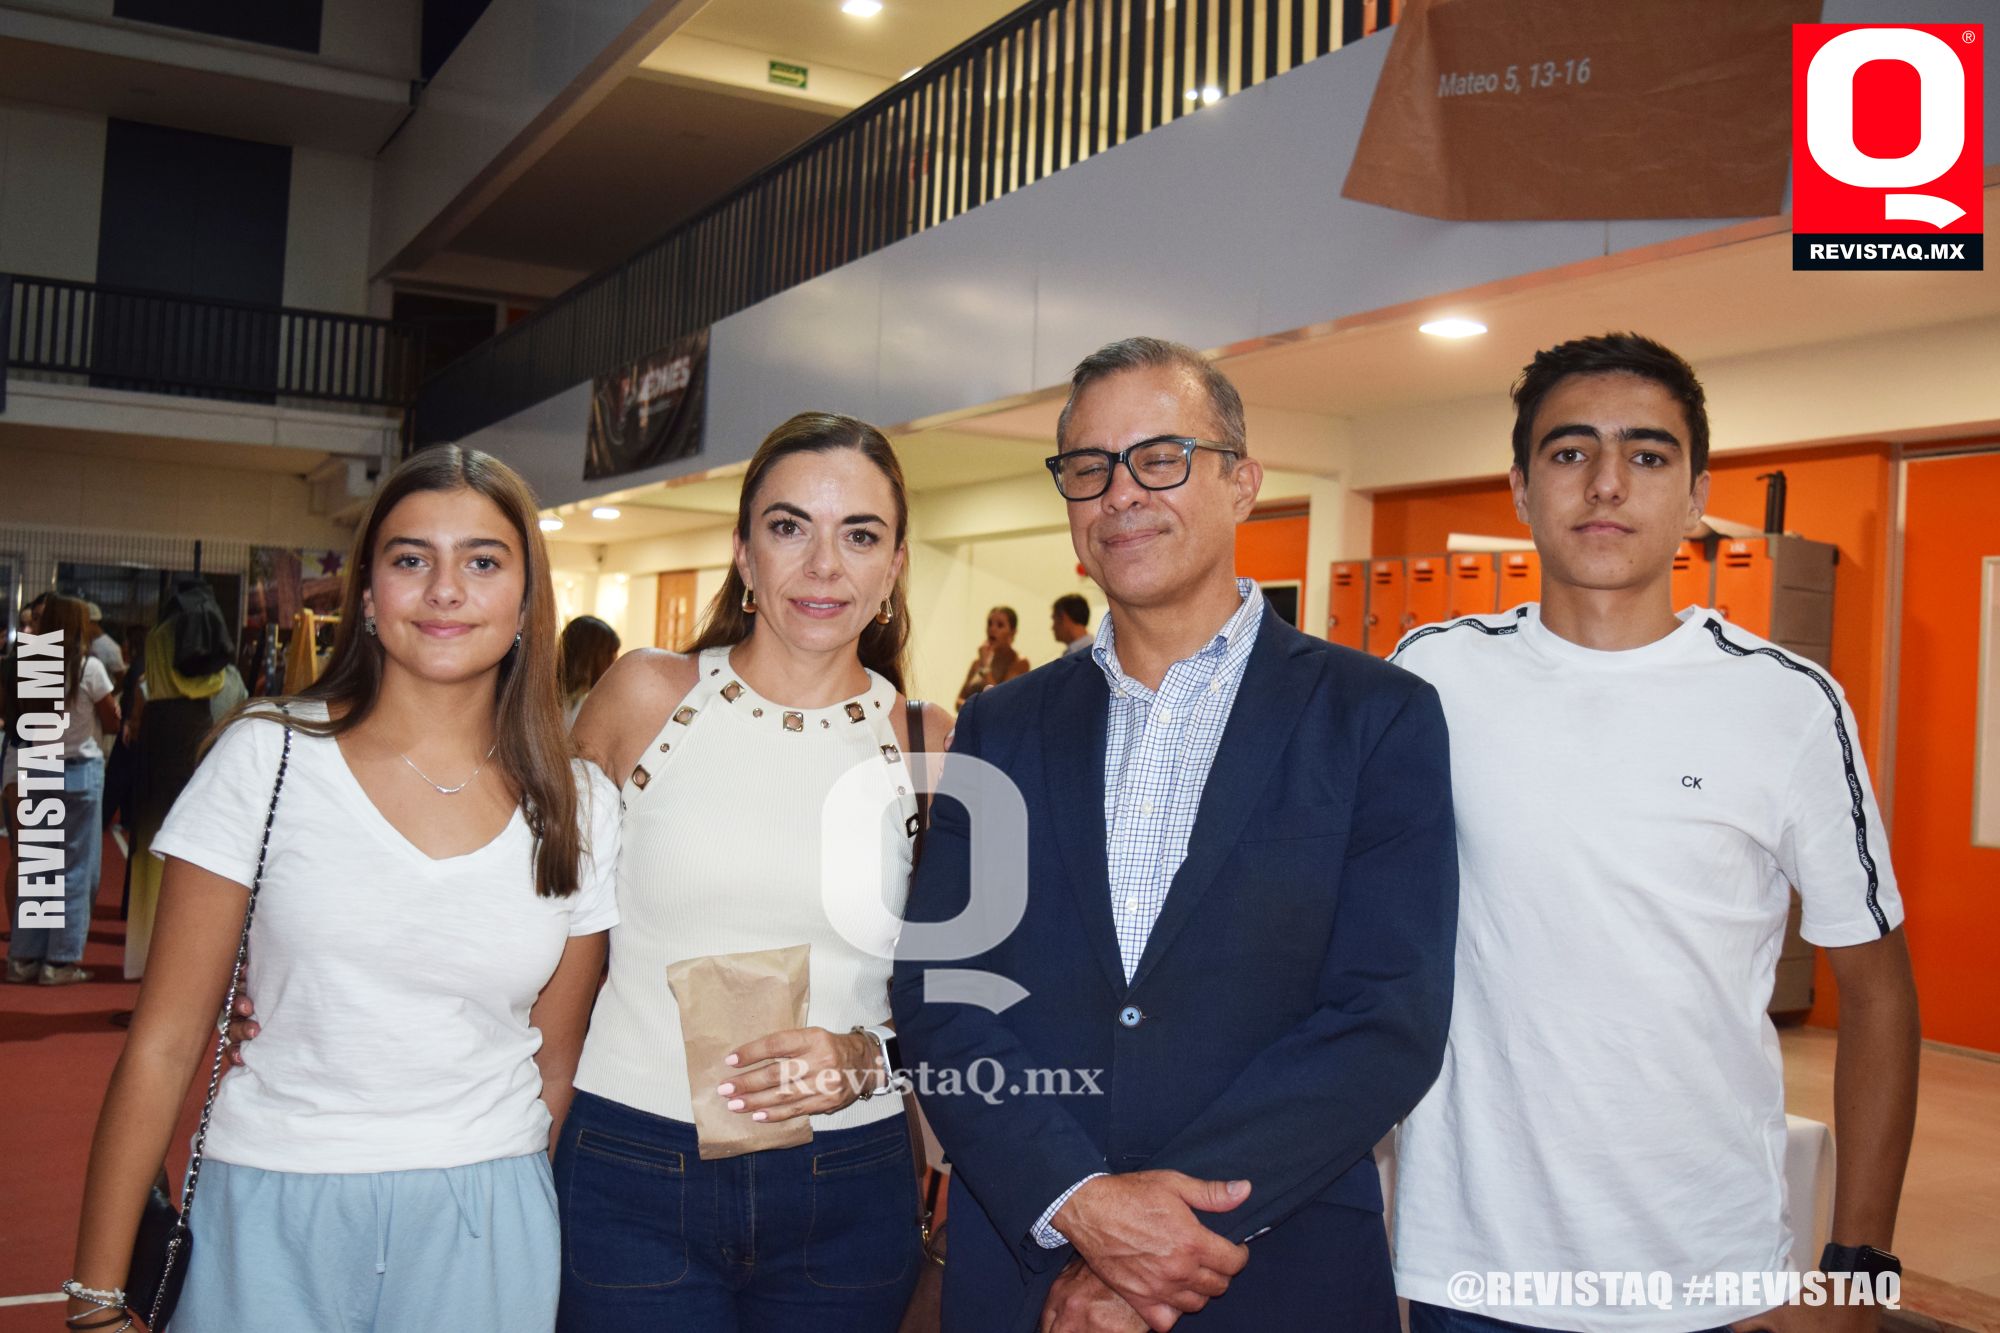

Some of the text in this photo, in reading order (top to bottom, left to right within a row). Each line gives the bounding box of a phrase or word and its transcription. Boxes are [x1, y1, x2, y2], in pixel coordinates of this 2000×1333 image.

[1437, 57, 1591, 98] Mateo 5, 13-16
[1470, 620, 1488, 633] Klein
[1724, 644, 1744, 656] Klein
[1807, 670, 1841, 708] Calvin Klein
[1836, 717, 1851, 764] Calvin Klein
[1681, 775, 1703, 790] CK
[1847, 773, 1860, 800] Calvin
[1857, 827, 1865, 854] Calvin
[1860, 852, 1873, 872] Klein
[1871, 905, 1884, 925] Klein
